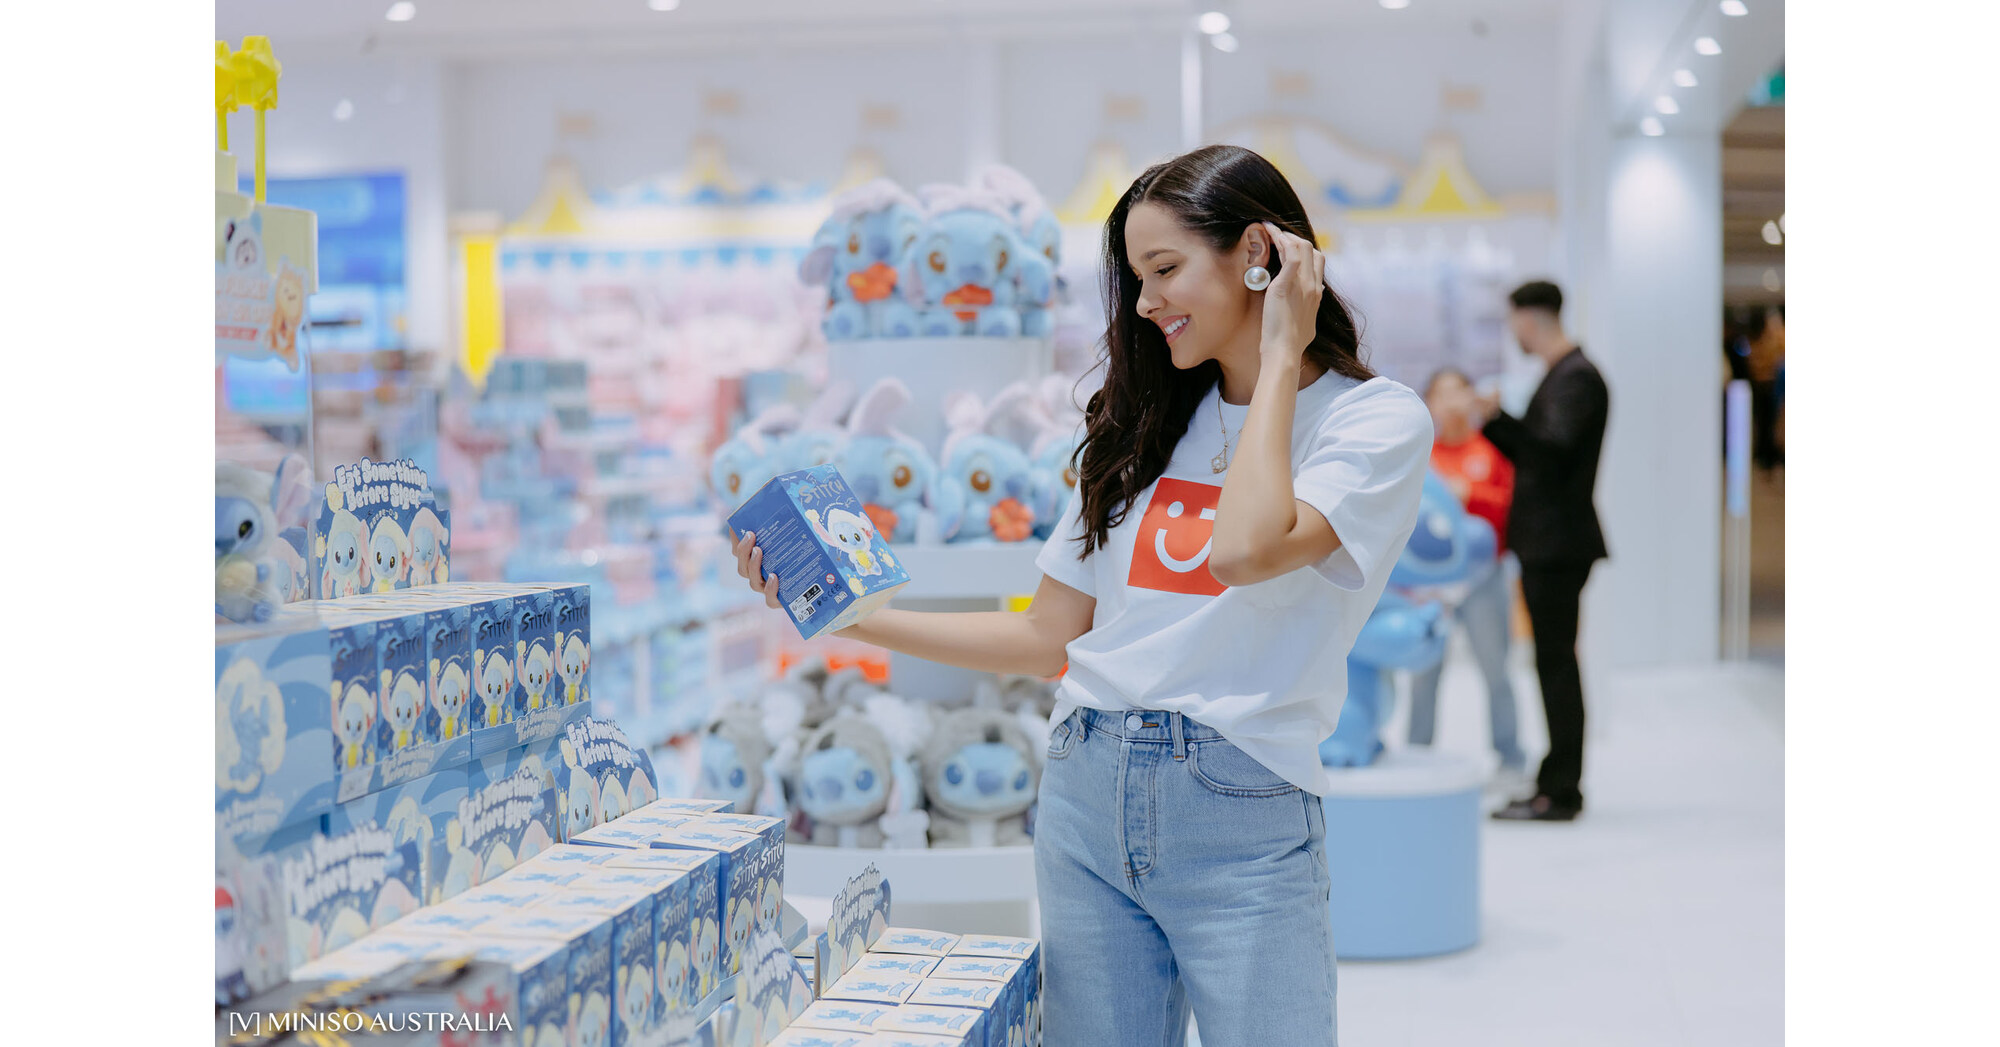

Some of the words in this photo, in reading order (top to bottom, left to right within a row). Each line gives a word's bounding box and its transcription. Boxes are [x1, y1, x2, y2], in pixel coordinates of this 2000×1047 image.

[798, 479, 846, 504] STITCH
[522, 611, 552, 633] STITCH
[761, 841, 784, 870] STITCH
[733, 859, 760, 889] STITCH
